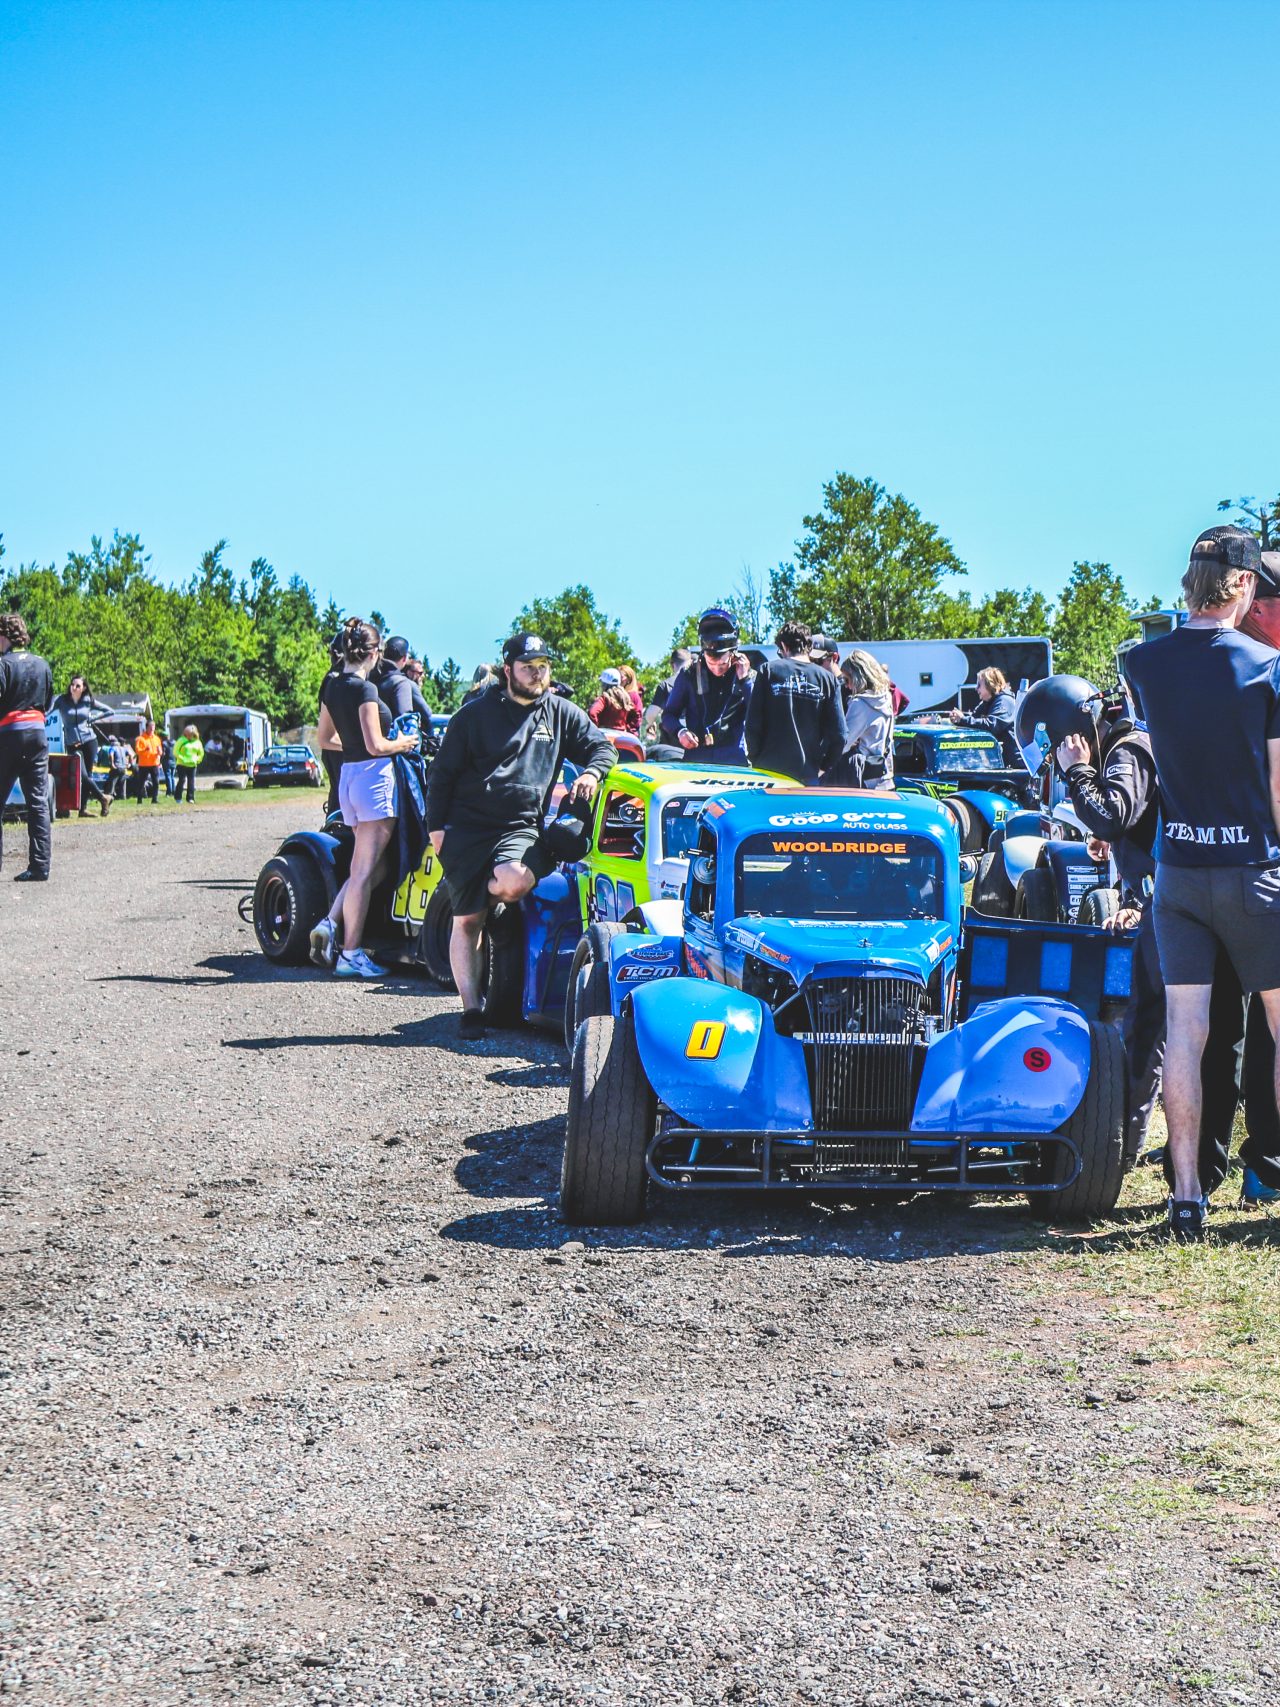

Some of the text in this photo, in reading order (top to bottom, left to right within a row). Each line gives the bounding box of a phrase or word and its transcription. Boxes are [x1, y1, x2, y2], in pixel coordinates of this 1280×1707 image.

[769, 813, 838, 827] GOOD
[1166, 822, 1249, 844] TEAM NL
[773, 842, 907, 853] WOOLDRIDGE
[1030, 1050, 1045, 1068] S
